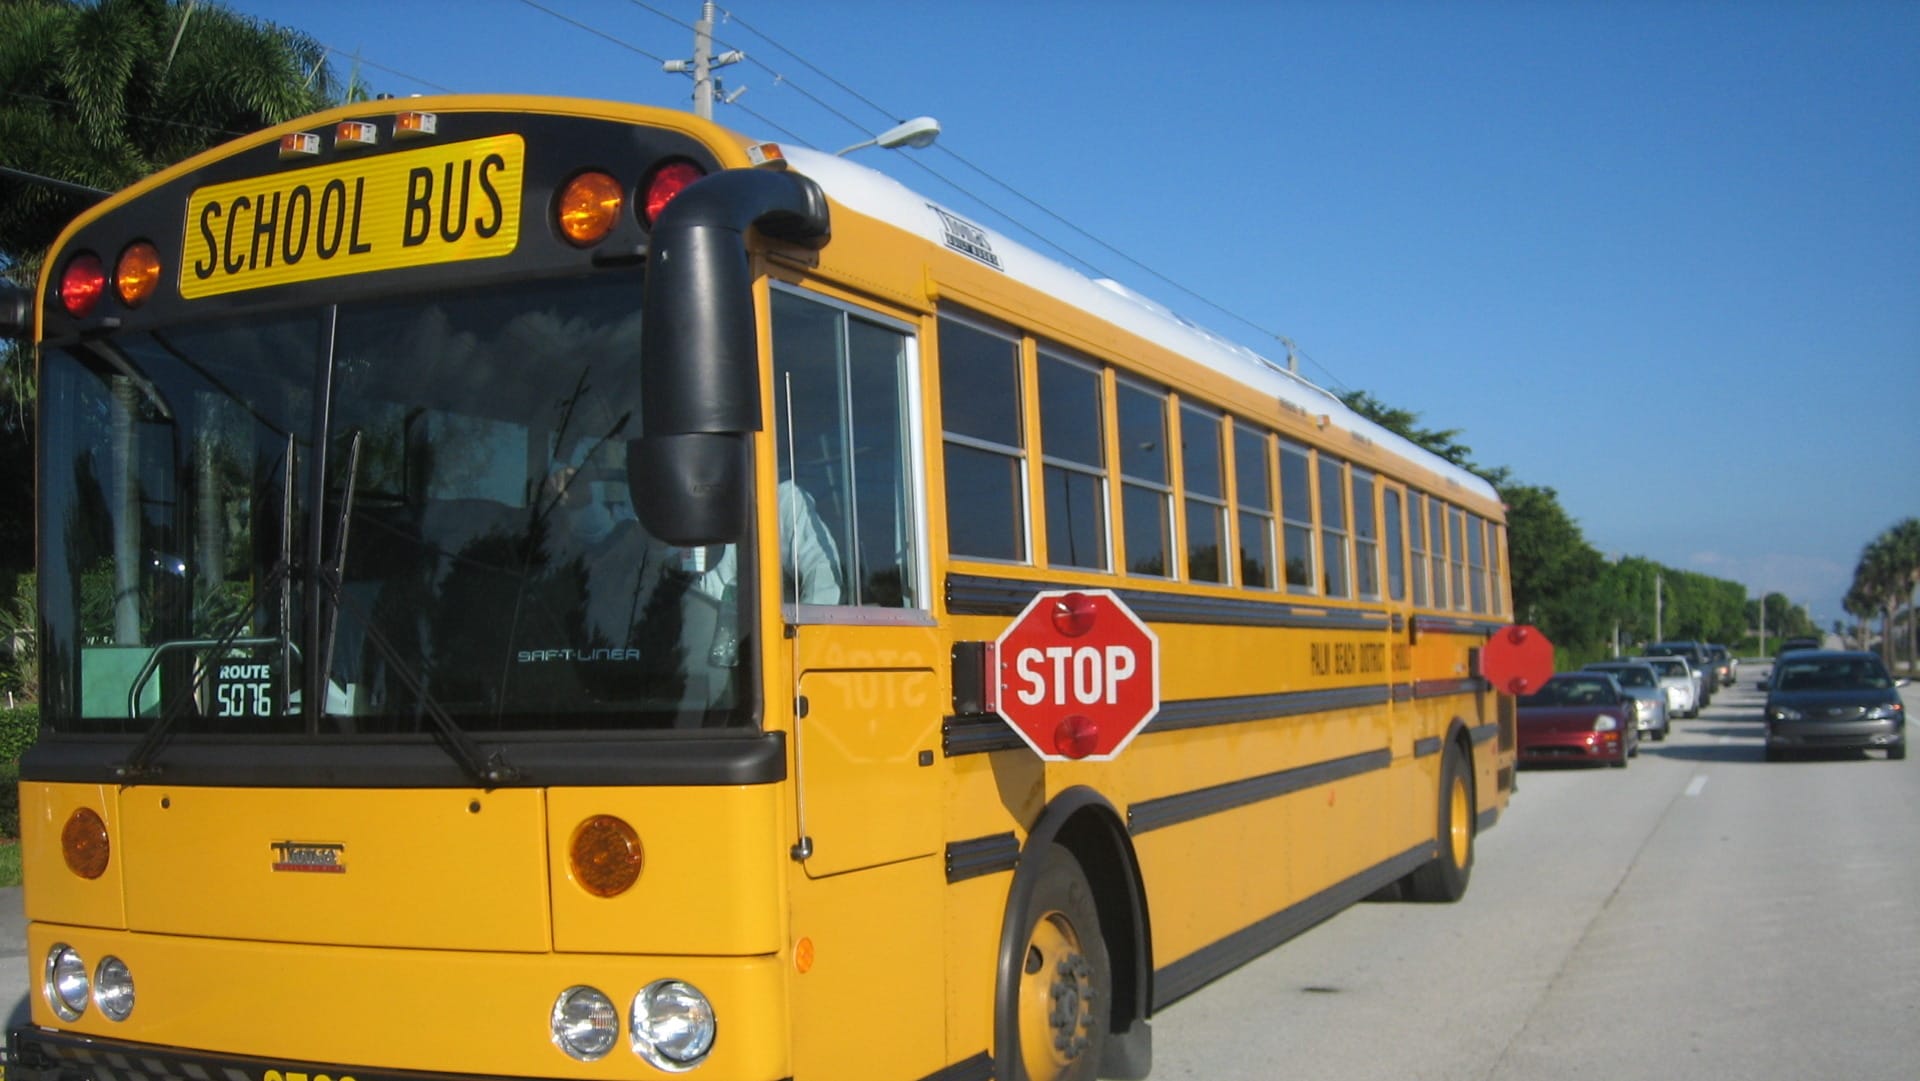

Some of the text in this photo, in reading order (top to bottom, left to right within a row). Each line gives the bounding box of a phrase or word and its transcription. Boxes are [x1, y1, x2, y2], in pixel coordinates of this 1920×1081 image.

[195, 154, 505, 279] SCHOOL BUS
[219, 665, 270, 679] ROUTE
[1016, 645, 1136, 705] STOP
[218, 683, 271, 716] 5076
